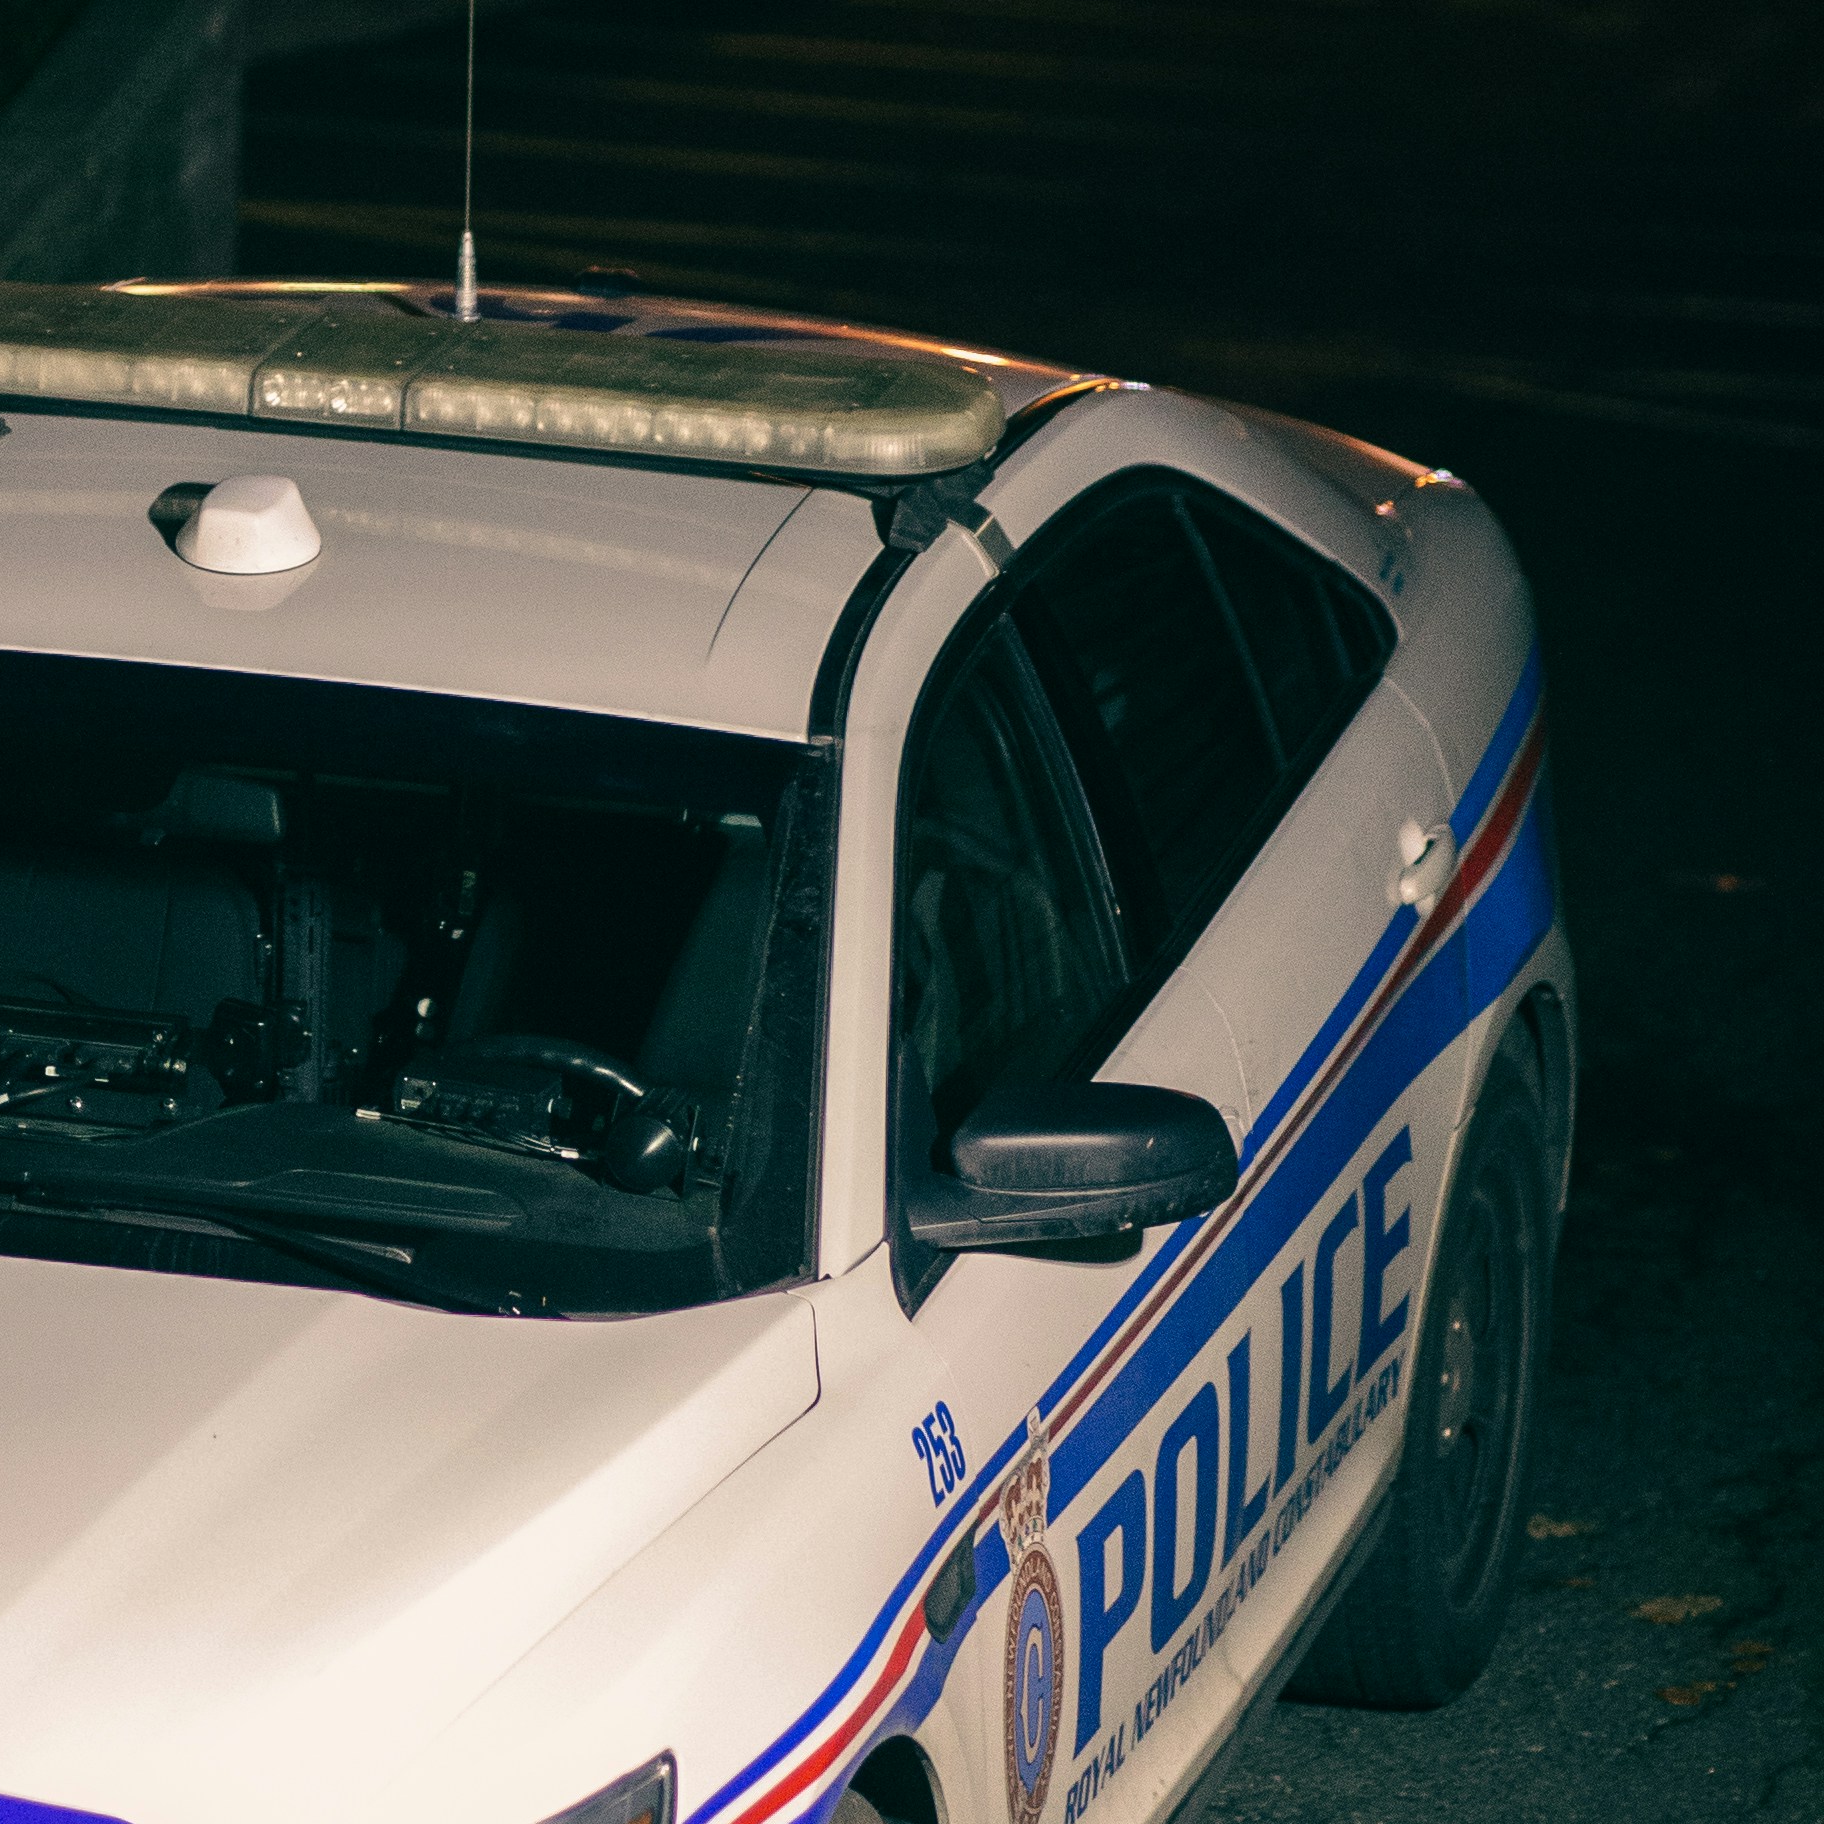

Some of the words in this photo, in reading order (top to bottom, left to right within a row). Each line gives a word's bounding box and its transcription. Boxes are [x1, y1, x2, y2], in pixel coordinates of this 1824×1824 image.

[911, 1400, 966, 1508] 253
[1074, 1124, 1412, 1760] POLICE
[1130, 1529, 1271, 1750] NEWFOUNDLAND
